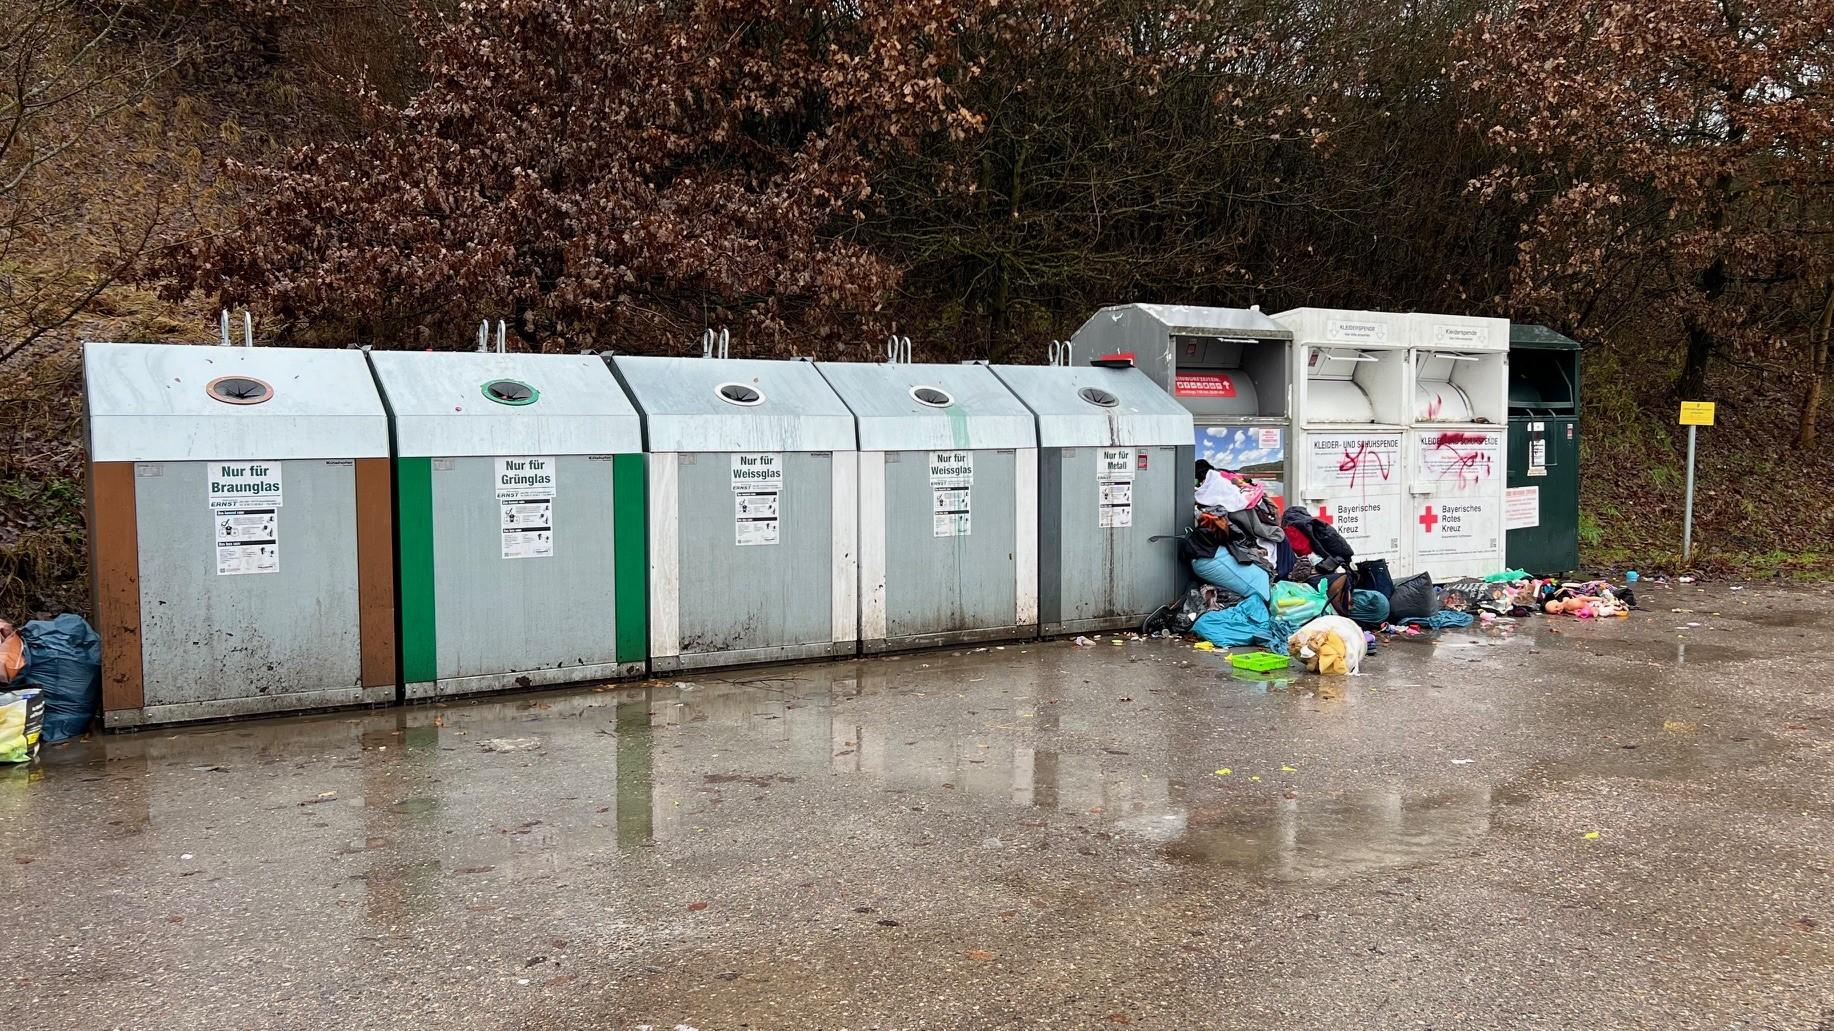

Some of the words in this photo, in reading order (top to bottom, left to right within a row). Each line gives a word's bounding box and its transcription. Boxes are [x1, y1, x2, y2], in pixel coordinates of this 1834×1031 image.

[1314, 440, 1341, 449] KLEIDER-
[1343, 441, 1355, 449] UND
[937, 454, 951, 463] Nur
[954, 454, 966, 463] für
[1104, 451, 1116, 459] Nur
[1118, 451, 1128, 459] für
[506, 460, 525, 470] Nur
[529, 460, 545, 470] für
[740, 456, 757, 465] Nur
[760, 456, 774, 465] für
[222, 466, 245, 477] Nur
[250, 465, 269, 476] für
[733, 469, 781, 480] Weissglas
[931, 466, 972, 476] Weissglas
[501, 474, 551, 486] Grünglas
[211, 481, 280, 494] Braunglas
[1338, 504, 1381, 514] Bayerisches
[1442, 505, 1482, 514] Bayerisches
[1338, 515, 1359, 524] Rotes
[1442, 515, 1461, 523] Rotes
[1338, 526, 1359, 534] Kreuz
[1442, 525, 1461, 533] Kreuz
